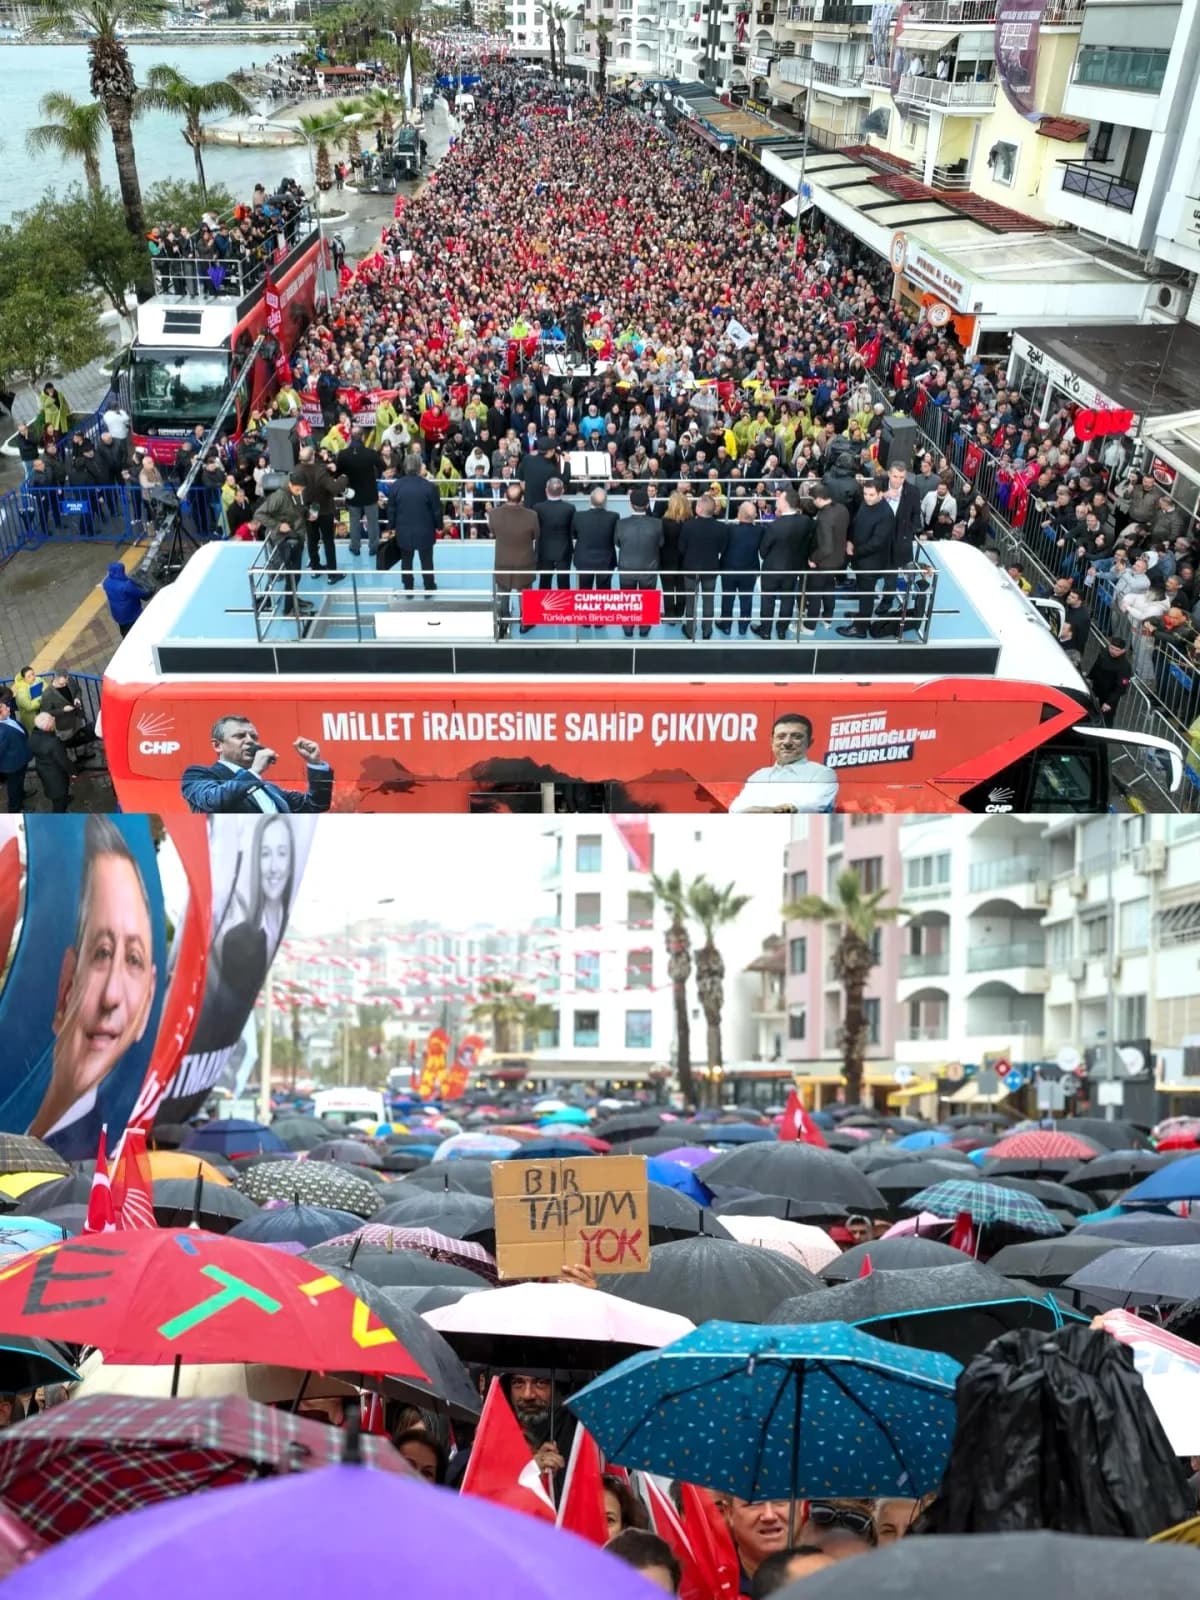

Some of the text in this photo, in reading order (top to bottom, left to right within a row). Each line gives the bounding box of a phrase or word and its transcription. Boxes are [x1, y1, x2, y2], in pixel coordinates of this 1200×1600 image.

[574, 592, 643, 602] CUMHURİYET
[574, 601, 643, 611] HALK PARTİSİ
[542, 613, 643, 622] Türkiye'nin Birinci Partisi
[651, 712, 758, 747] ÇIKIYOR
[830, 716, 886, 737] EKREM
[139, 741, 181, 755] CHP
[826, 745, 911, 768] ÖZGÜRLÜK
[985, 804, 1013, 813] CHP
[520, 1191, 637, 1230] TAPUM
[579, 1227, 642, 1267] YOK
